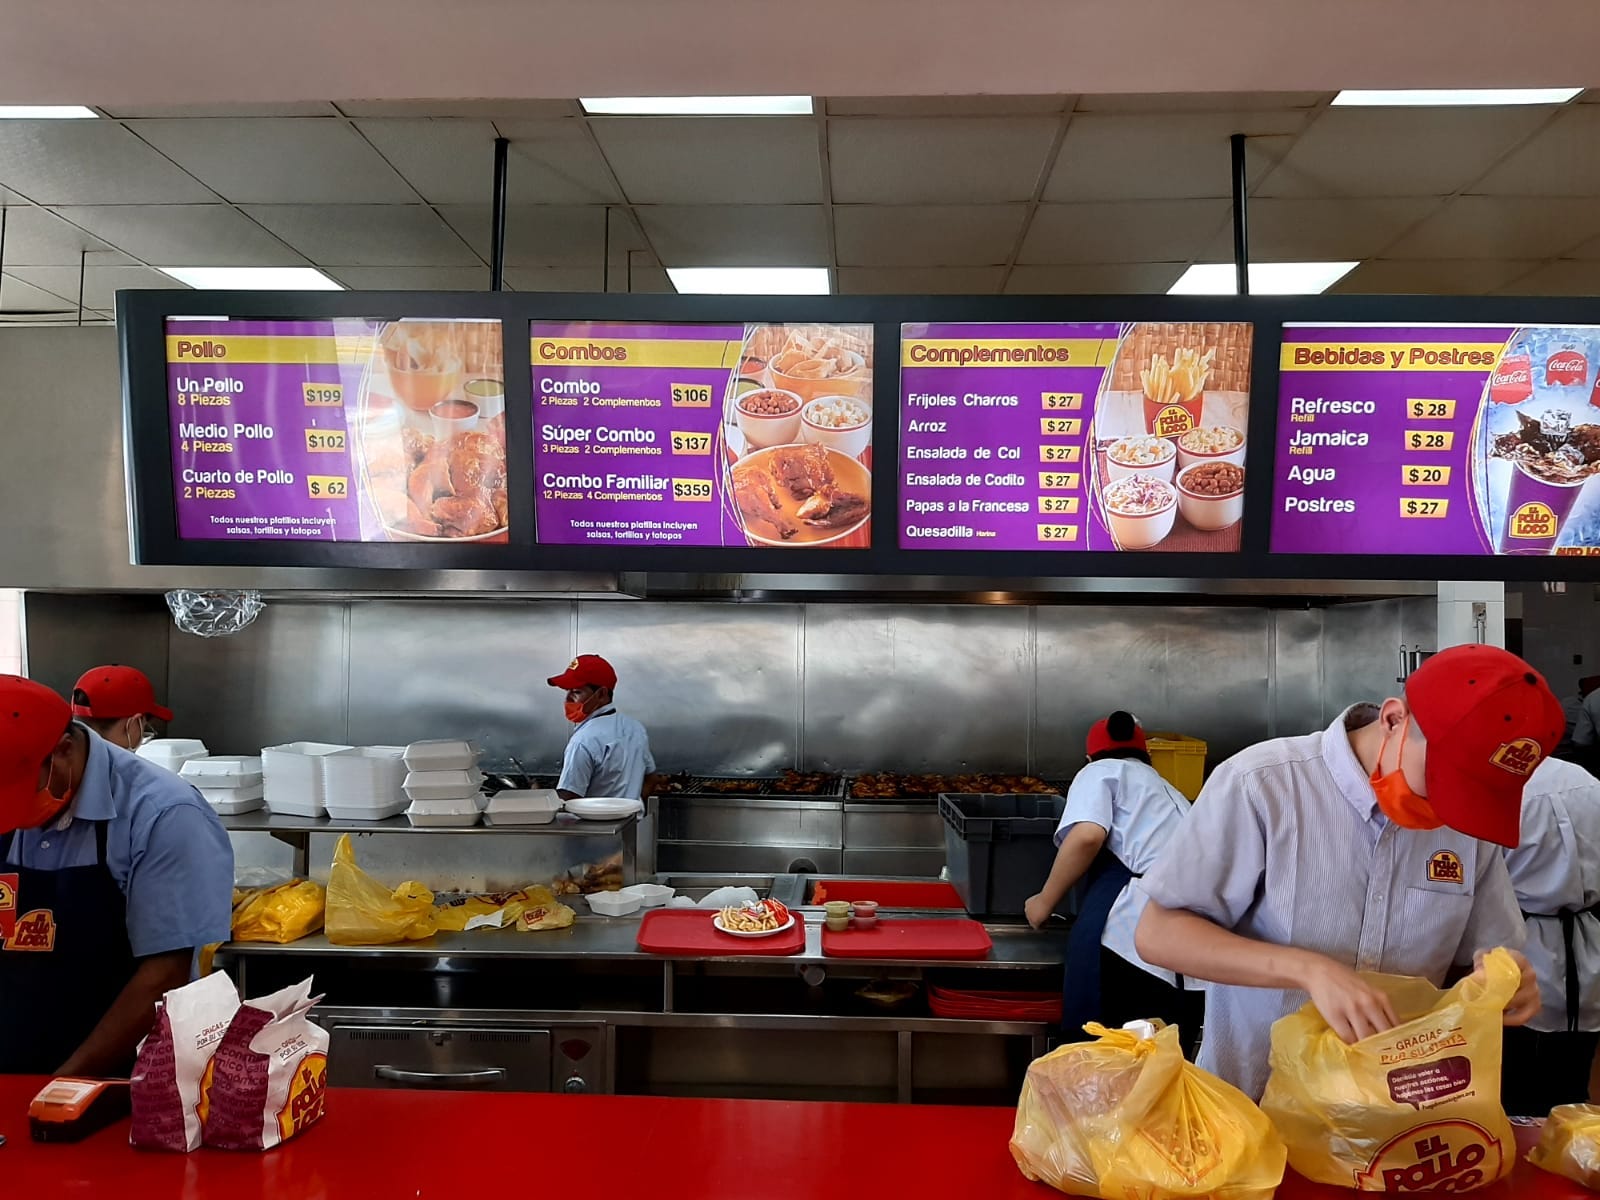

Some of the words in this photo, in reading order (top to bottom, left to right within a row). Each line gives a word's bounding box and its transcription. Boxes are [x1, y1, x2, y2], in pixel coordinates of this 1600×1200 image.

[177, 341, 226, 358] Pollo
[539, 342, 627, 361] Combos
[910, 345, 1069, 365] Complementos
[1294, 347, 1385, 365] Bebidas
[1390, 350, 1405, 368] y
[1409, 347, 1495, 365] Postres
[176, 377, 199, 392] Un
[203, 377, 244, 393] Pollo
[540, 377, 601, 394] Combo
[178, 393, 186, 406] 8
[190, 394, 231, 406] Piezas
[306, 388, 341, 402] $199
[908, 394, 957, 409] Frijoles
[963, 394, 1018, 406] Charros
[541, 396, 547, 405] 2
[548, 396, 578, 406] Piezas
[584, 397, 590, 406] 2
[591, 397, 661, 409] Complementos
[1291, 398, 1376, 414] Refresco
[1290, 414, 1315, 422] Refill
[179, 423, 228, 438] Medio
[234, 423, 274, 439] Pollo
[908, 419, 947, 432] Arroz
[308, 434, 344, 448] $102
[542, 424, 591, 444] Súper
[596, 426, 655, 443] Combo
[1289, 429, 1369, 446] Jamaica
[181, 441, 189, 452] 4
[193, 441, 234, 452] Piezas
[542, 444, 548, 452] 3
[550, 445, 580, 453] Piezas
[585, 445, 590, 453] 2
[592, 445, 662, 457] Complementos
[907, 446, 967, 459] Ensalada
[974, 446, 991, 459] de
[998, 446, 1020, 459] Col
[1289, 446, 1313, 455] Refill
[182, 469, 231, 483] Cuarto
[235, 469, 254, 483] de
[257, 469, 294, 484] Pollo
[543, 473, 602, 488] Combo
[606, 474, 669, 490] Familiar
[906, 473, 962, 486] Ensalada
[965, 473, 981, 486] de
[984, 473, 1025, 486] Codito
[1287, 465, 1336, 485] Agua
[184, 487, 192, 498] 2
[196, 487, 236, 499] Piezas
[543, 490, 552, 499] 12
[554, 491, 583, 500] Piezas
[587, 491, 593, 500] 4
[594, 492, 663, 503] Complementos
[674, 484, 710, 497] $359
[906, 499, 944, 514] Papas
[948, 502, 956, 512] a
[959, 500, 970, 512] la
[972, 500, 1029, 512] Francesa
[1285, 497, 1355, 512] Postres
[210, 515, 234, 524] Todos
[235, 516, 268, 525] nuestros
[570, 519, 594, 528] Todos
[595, 520, 630, 528] nuestros
[1518, 514, 1550, 523] POLLO
[284, 528, 289, 537] y
[645, 532, 650, 540] y
[906, 525, 973, 538] Quesadilla
[1517, 524, 1549, 534] LOCO
[1415, 1135, 1449, 1160] EL
[1382, 1143, 1486, 1192] POLLO
